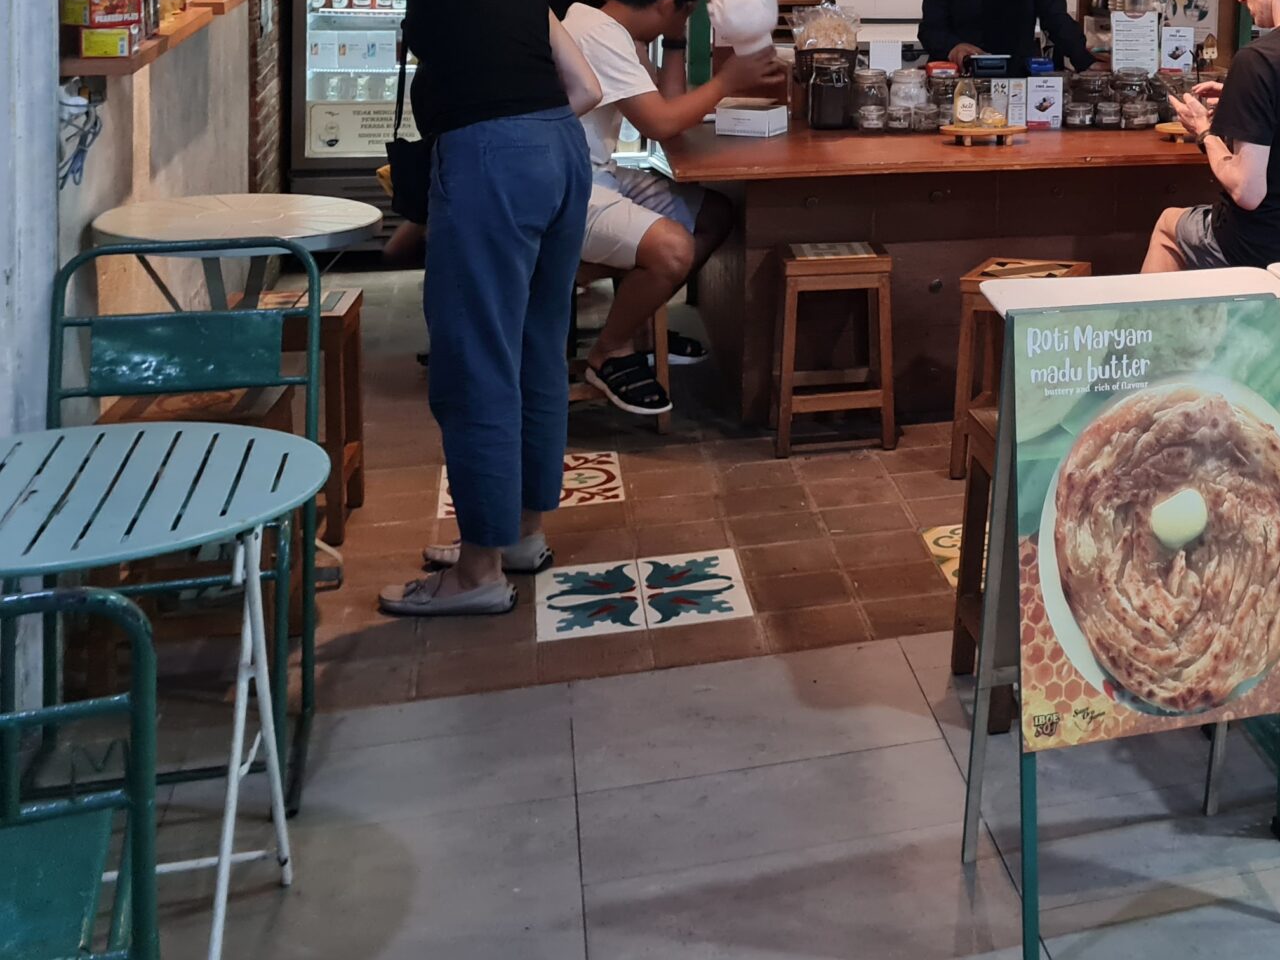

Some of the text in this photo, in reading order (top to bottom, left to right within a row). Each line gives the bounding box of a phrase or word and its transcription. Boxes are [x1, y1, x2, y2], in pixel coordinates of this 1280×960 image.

[1026, 324, 1153, 358] Roti Maryam
[1030, 355, 1151, 384] madu butter
[1044, 386, 1075, 398] buttery
[1075, 384, 1091, 394] and
[1094, 382, 1110, 393] rich
[1111, 381, 1120, 391] of
[1033, 711, 1061, 727] IBOE
